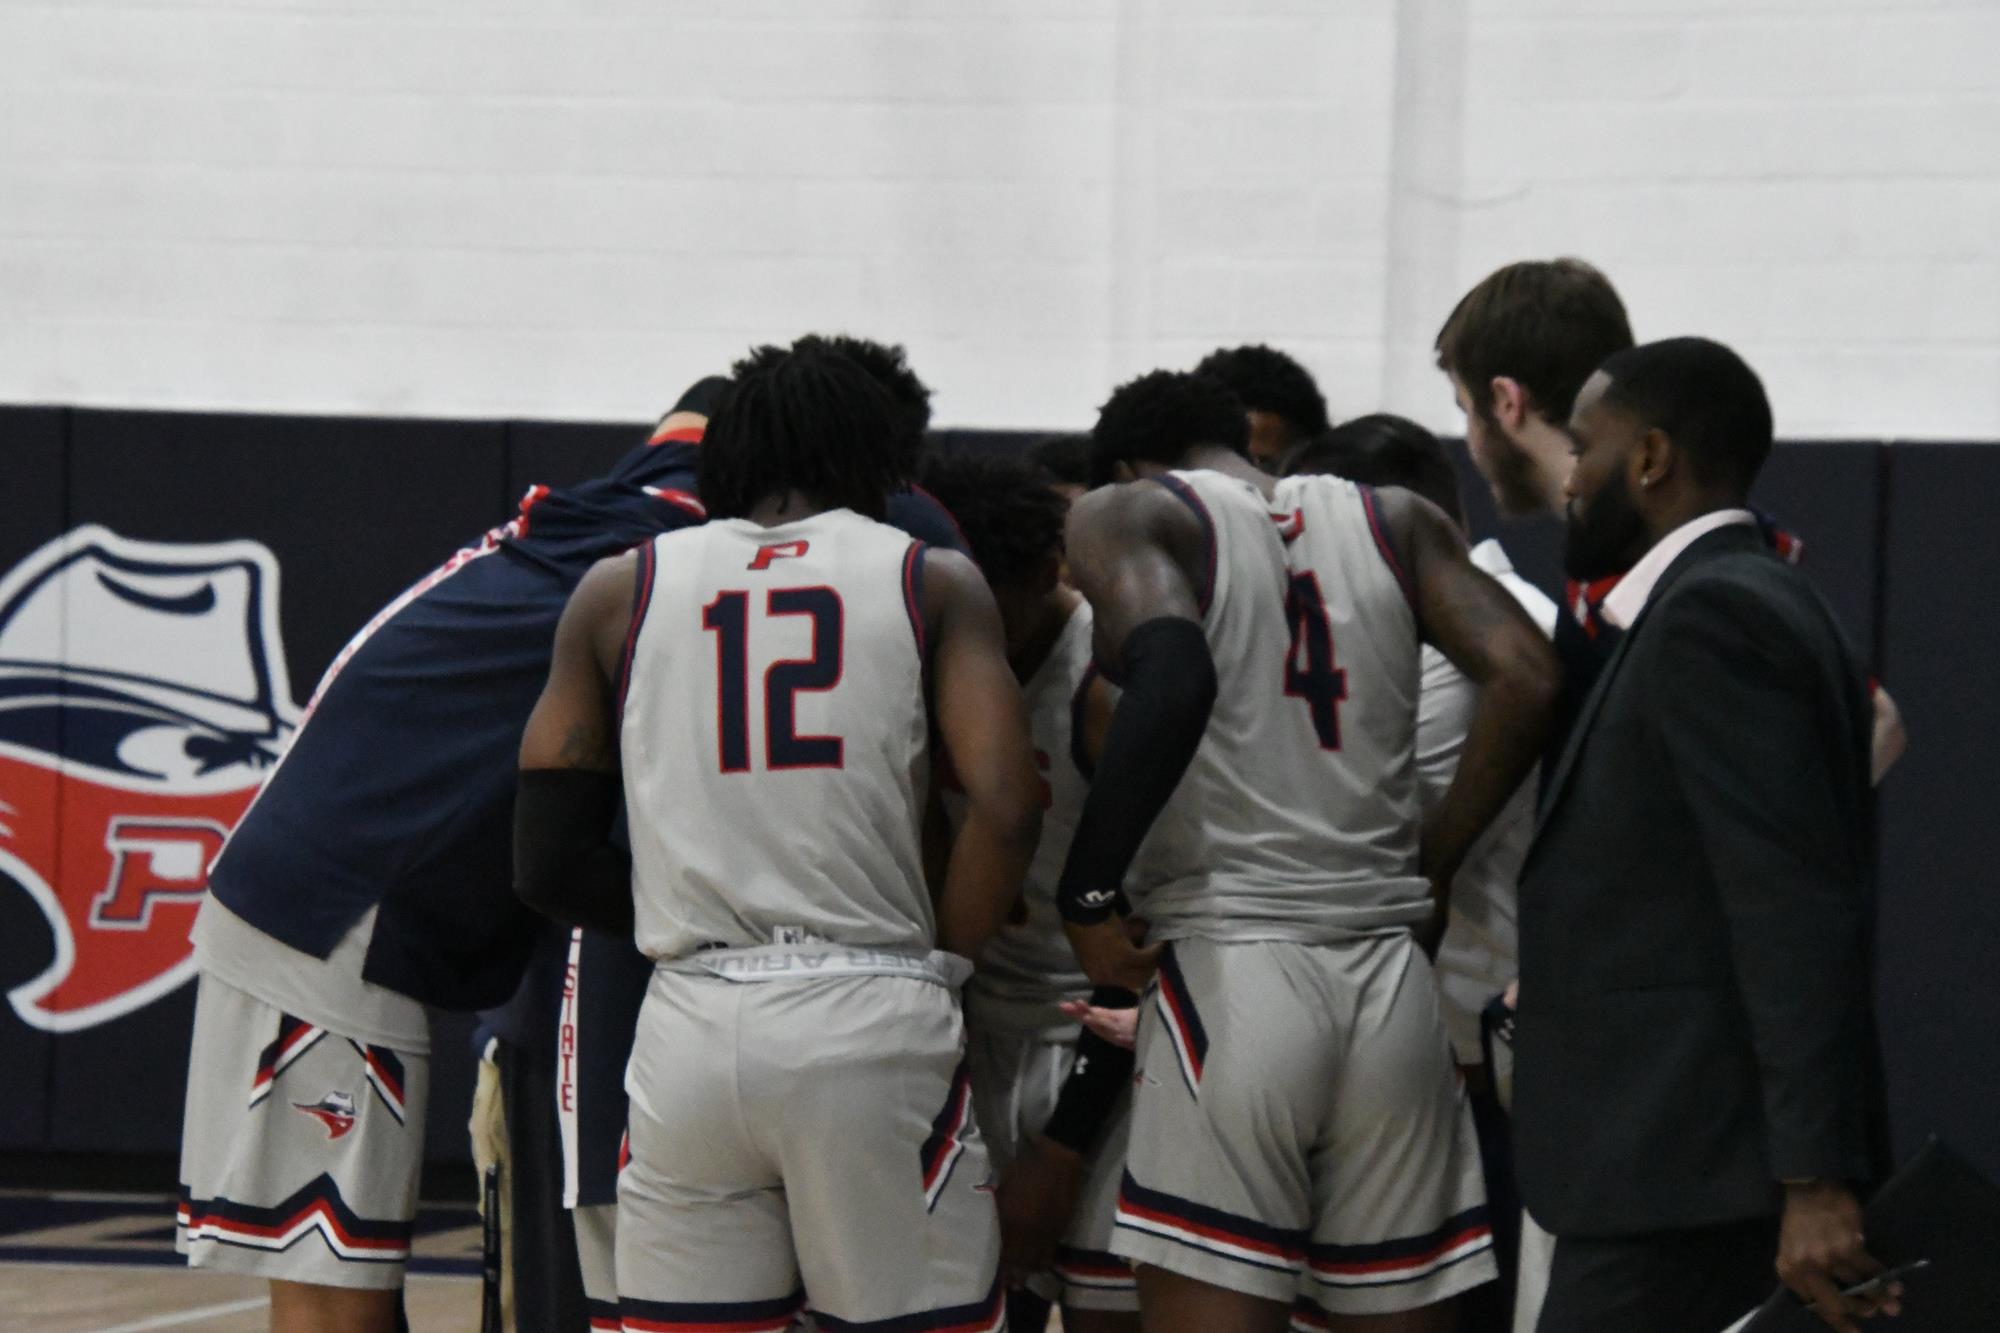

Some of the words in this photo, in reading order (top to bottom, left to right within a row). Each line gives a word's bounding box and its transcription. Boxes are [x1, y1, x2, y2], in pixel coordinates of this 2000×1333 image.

[747, 539, 809, 570] P
[702, 585, 844, 774] 12
[1283, 567, 1347, 751] 4
[90, 817, 228, 928] P
[561, 963, 577, 1112] STATE
